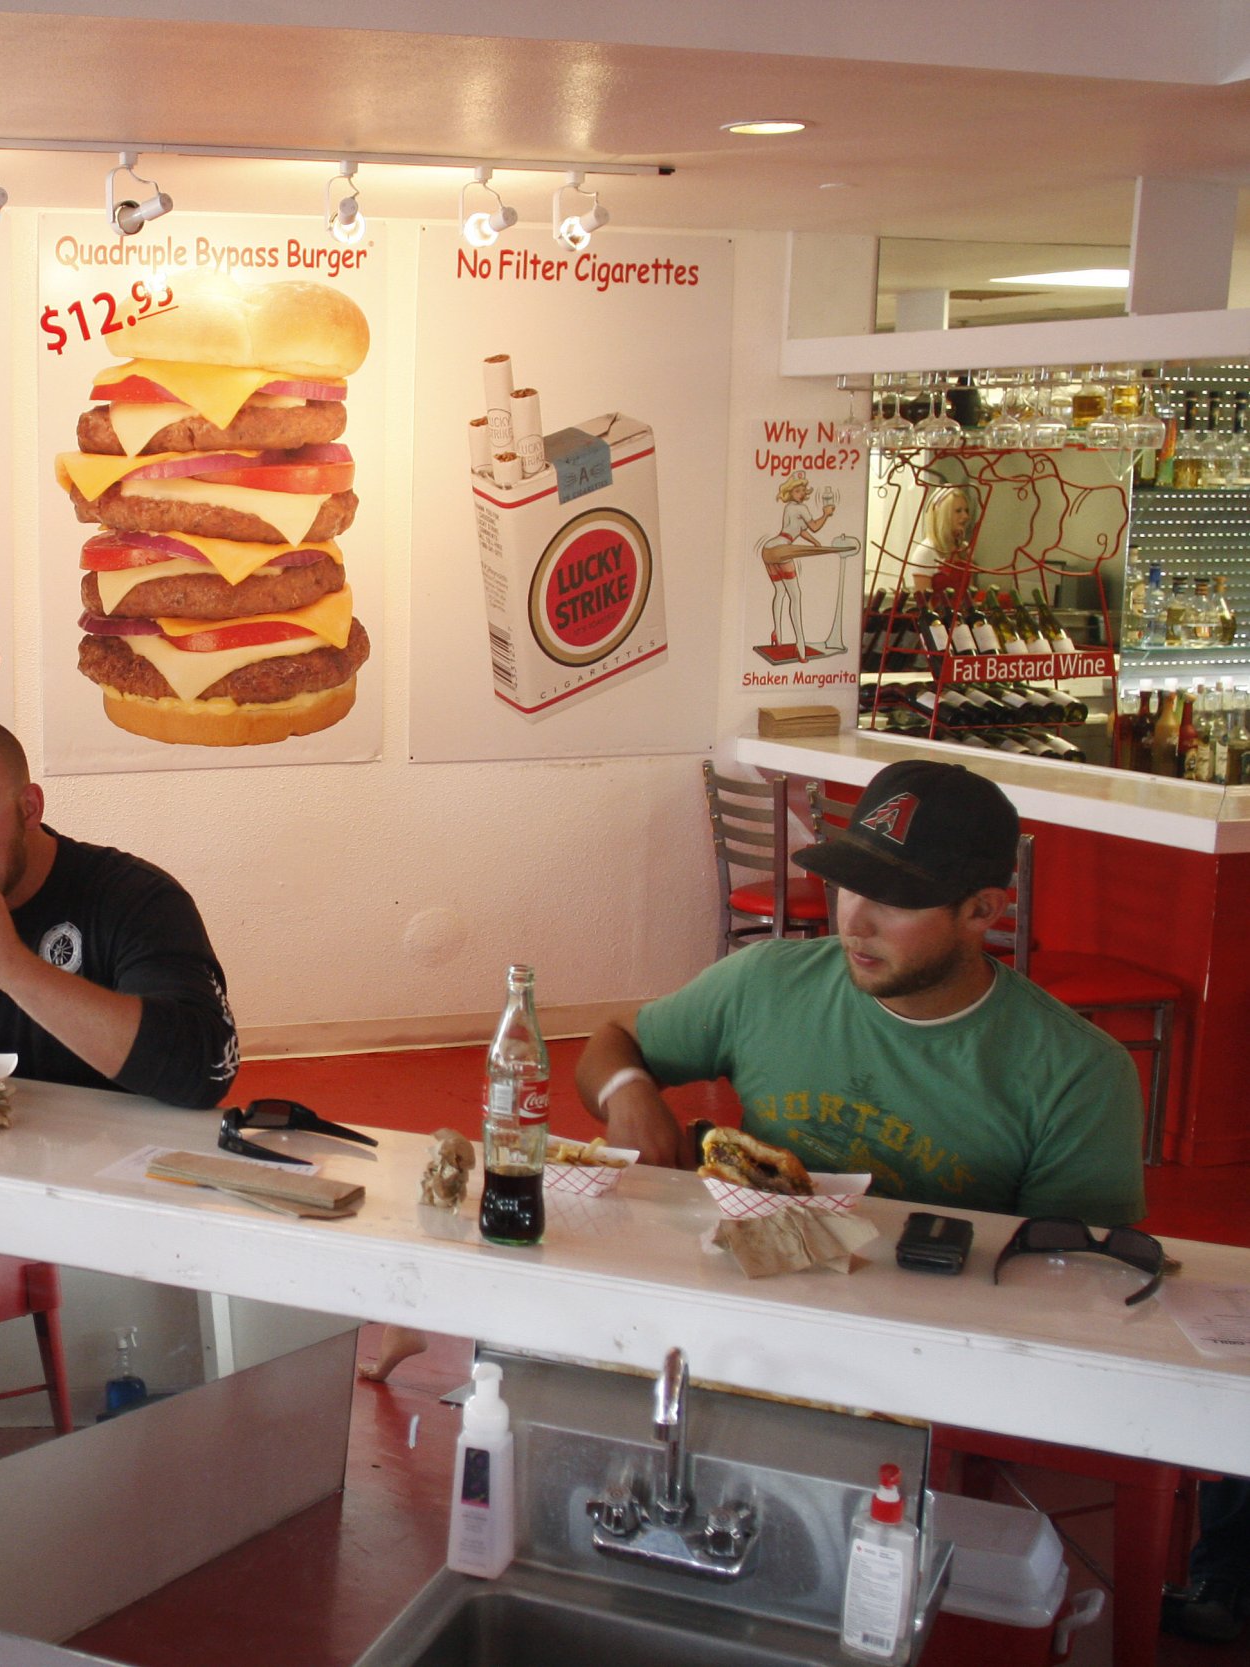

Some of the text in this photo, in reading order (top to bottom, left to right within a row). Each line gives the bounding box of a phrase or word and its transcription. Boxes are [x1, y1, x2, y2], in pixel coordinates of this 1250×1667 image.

[55, 235, 187, 274] Quadruple
[196, 237, 279, 275] Bypass
[457, 248, 699, 292] No Filter Cigarettes
[764, 420, 808, 449] Why
[755, 449, 860, 477] Upgrade??
[557, 543, 623, 595] LUCKY
[555, 573, 629, 630] STRIKE
[540, 640, 655, 699] CIGARETTES
[742, 670, 857, 688] Shaken Margarita
[953, 654, 1105, 682] Fat Bastard Wine
